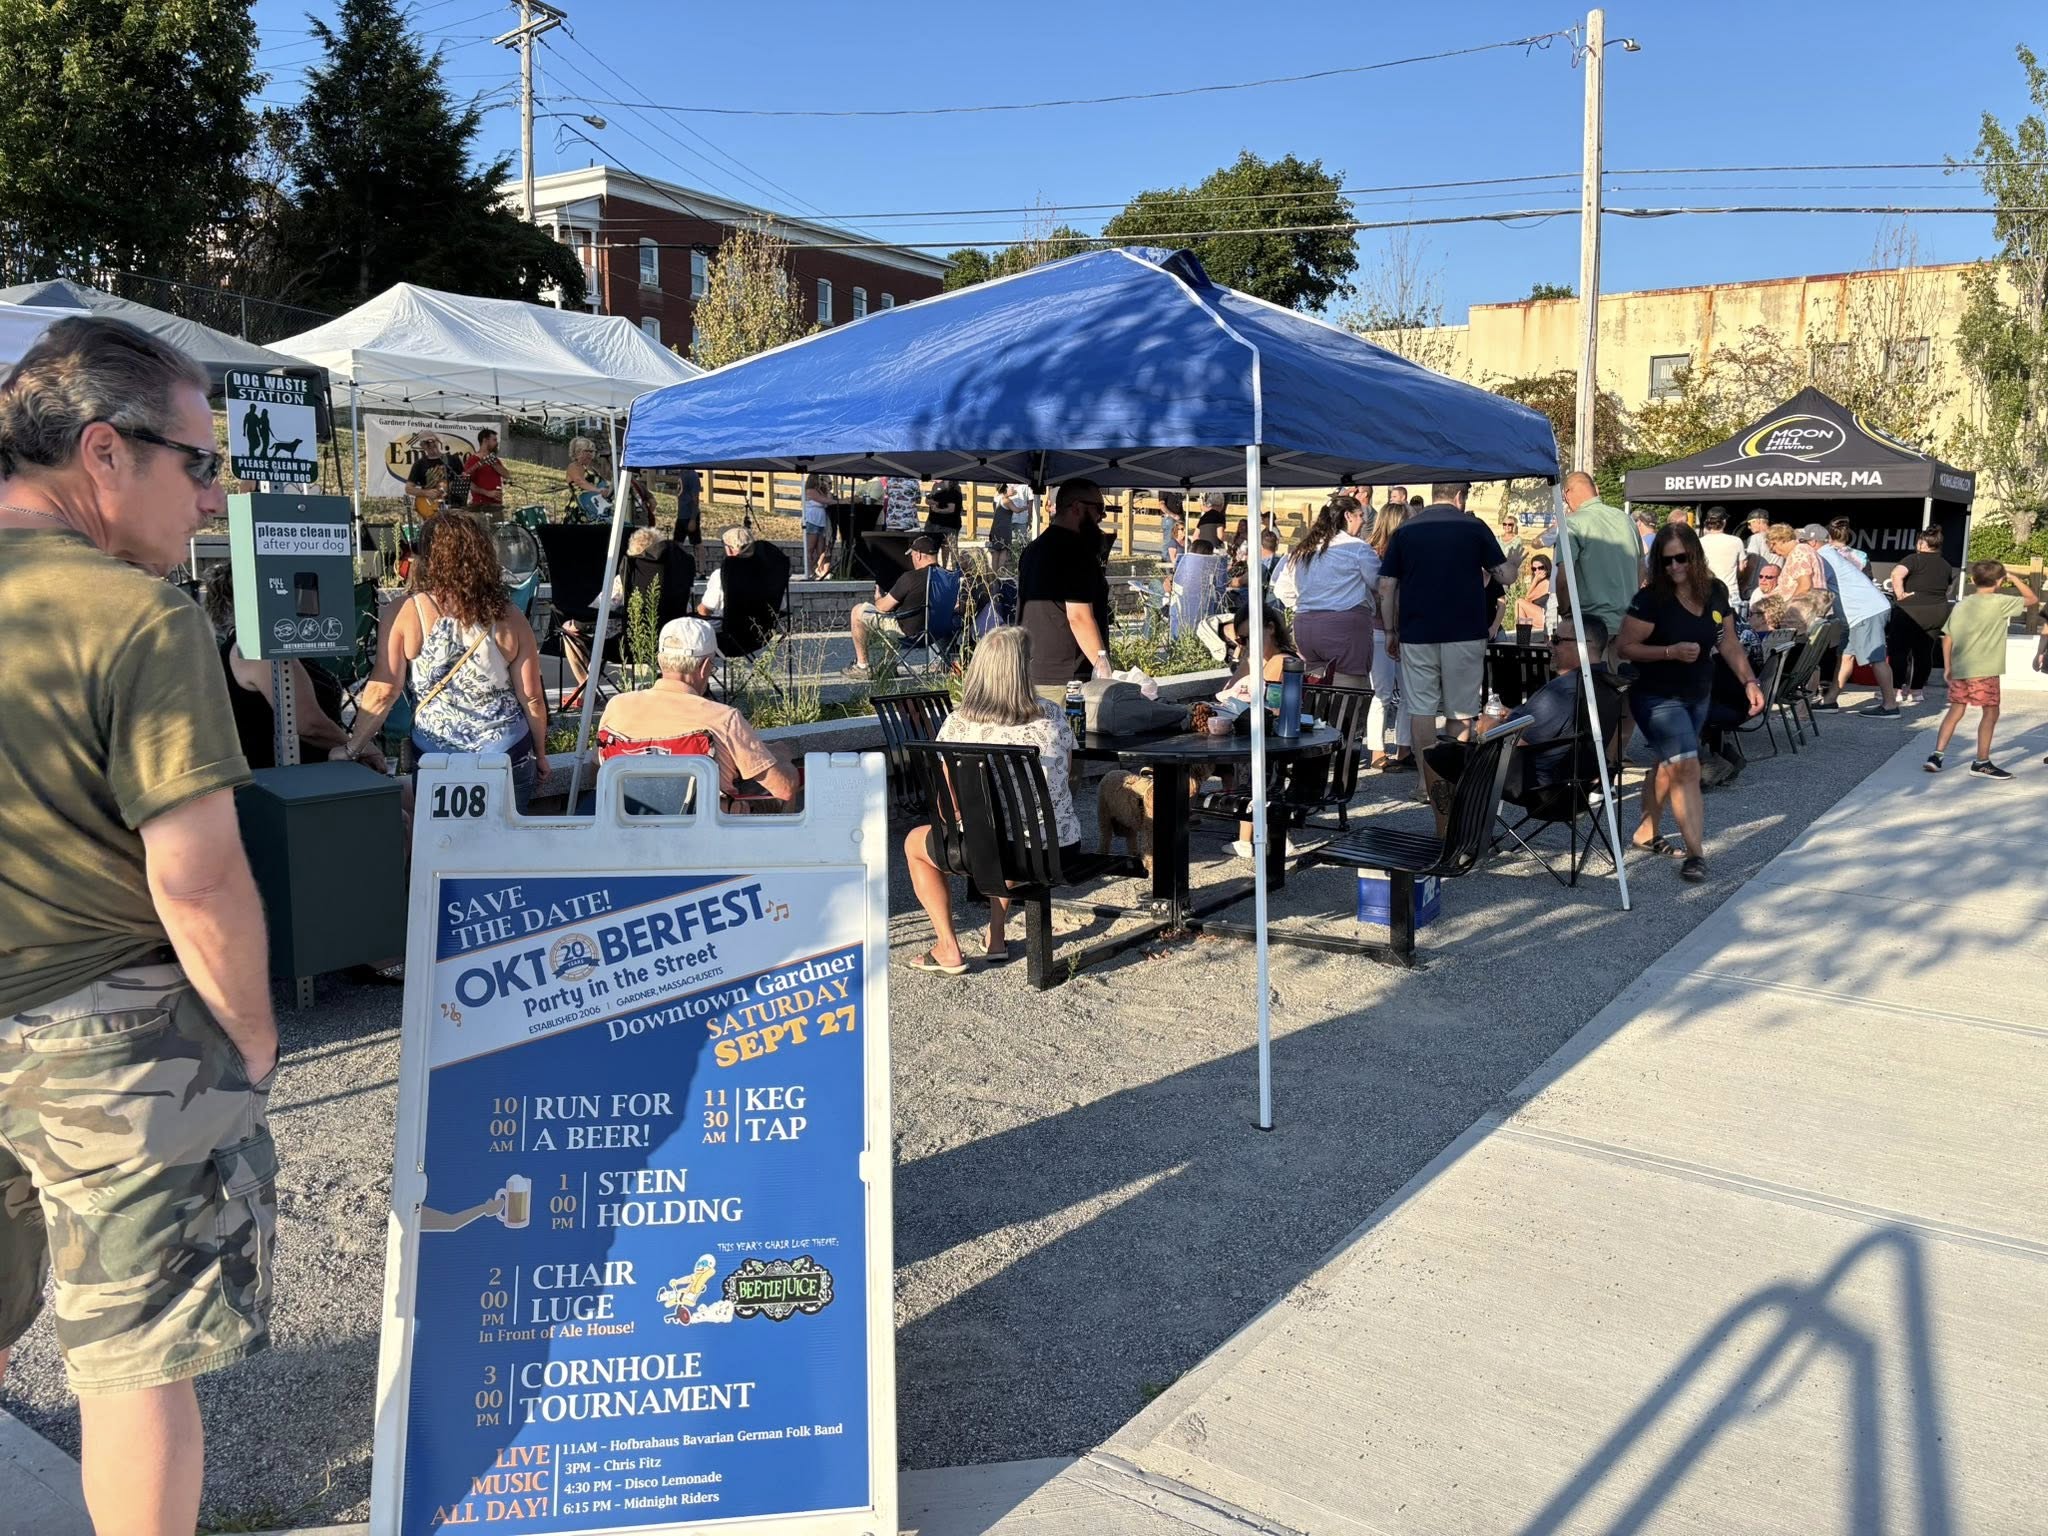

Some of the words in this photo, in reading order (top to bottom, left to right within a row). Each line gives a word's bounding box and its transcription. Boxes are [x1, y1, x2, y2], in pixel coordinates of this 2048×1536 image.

[233, 373, 259, 387] DOG
[264, 376, 307, 392] WASTE
[239, 389, 304, 404] STATION
[407, 420, 432, 428] Festival
[1771, 429, 1834, 439] MOON
[1767, 438, 1800, 446] HILL
[238, 459, 269, 469] PLEASE
[271, 461, 298, 470] CLEAN
[300, 463, 311, 472] UP
[240, 470, 266, 480] AFTER
[269, 472, 291, 481] YOUR
[294, 473, 311, 483] DOG
[1665, 476, 1732, 490] BREWED
[1735, 474, 1752, 488] IN
[1756, 471, 1847, 488] GARDNER,
[1851, 471, 1883, 485] MA
[258, 525, 297, 538] please
[300, 526, 331, 537] clean
[334, 528, 347, 539] up
[263, 538, 290, 549] after
[294, 541, 319, 552] your
[322, 540, 344, 553] dog
[433, 785, 486, 818] 108
[447, 885, 526, 925] SAVE
[452, 915, 515, 950] THE
[521, 889, 613, 933] DATE!
[560, 941, 585, 962] 20
[523, 986, 584, 1018] Party
[588, 979, 610, 998] in
[613, 967, 649, 990] the
[654, 942, 718, 977] Street
[529, 1013, 578, 1034] ESTABLISHED
[580, 1006, 601, 1020] 2006
[616, 988, 659, 1008] GARDNER,
[658, 967, 724, 995] MASSACHUSETTS
[606, 986, 750, 1042] Downtown
[755, 953, 856, 997] Gardner
[706, 977, 850, 1040] SATURDAY
[714, 1013, 808, 1068] SEPT
[816, 1004, 856, 1036] 27
[492, 1097, 517, 1115] 10
[534, 1095, 600, 1120] RUN
[611, 1092, 673, 1117] FOR
[704, 1089, 726, 1106] 11
[745, 1086, 806, 1111] KEG
[490, 1119, 517, 1136] 00
[703, 1111, 729, 1128] 30
[745, 1116, 807, 1142] TAP
[488, 1141, 514, 1152] AM
[533, 1128, 557, 1151] A
[567, 1124, 650, 1150] BEER!
[702, 1132, 726, 1144] AM
[559, 1174, 569, 1191] 1
[598, 1168, 688, 1196] STEIN
[550, 1196, 576, 1213] 00
[597, 1197, 743, 1227] HOLDING
[552, 1217, 574, 1229] PM
[717, 1243, 734, 1252] THIS
[736, 1241, 763, 1251] YEAR'S
[764, 1240, 790, 1249] CHAIR
[791, 1239, 810, 1249] LUGE
[488, 1268, 501, 1285] 2
[533, 1261, 637, 1291] CHAIR
[738, 1277, 818, 1301] BEETLEJUICE
[480, 1291, 508, 1309] 00
[531, 1294, 614, 1324] LUGE
[481, 1313, 504, 1326] PM
[479, 1330, 494, 1343] In
[498, 1327, 536, 1342] Front
[540, 1325, 556, 1339] of
[558, 1324, 583, 1338] Ale
[586, 1321, 635, 1336] House!
[484, 1367, 496, 1383] 3
[520, 1352, 702, 1388] CORNHOLE
[475, 1390, 502, 1409] 00
[519, 1381, 756, 1424] TOURNAMENT
[476, 1413, 499, 1426] PM
[563, 1441, 597, 1455] 11AM
[610, 1434, 679, 1452] Hofbrahaus
[683, 1431, 734, 1447] Bavarian
[737, 1428, 783, 1443] German
[786, 1424, 811, 1438] Folk
[814, 1422, 843, 1436] Band
[495, 1444, 550, 1468] LIVE
[564, 1462, 592, 1475] 3PM
[603, 1457, 635, 1471] Chris
[639, 1456, 661, 1470] Fitz
[471, 1471, 549, 1496] MUSIC
[564, 1482, 589, 1495] 4:30
[592, 1480, 612, 1493] PM
[624, 1476, 658, 1490] Disco
[661, 1471, 722, 1487] Lemonade
[430, 1503, 479, 1526] ALL
[485, 1497, 548, 1521] DAY!
[563, 1502, 589, 1515] 6:15
[592, 1499, 612, 1512] PM
[624, 1495, 677, 1512] Midnight
[680, 1490, 720, 1505] Riders
